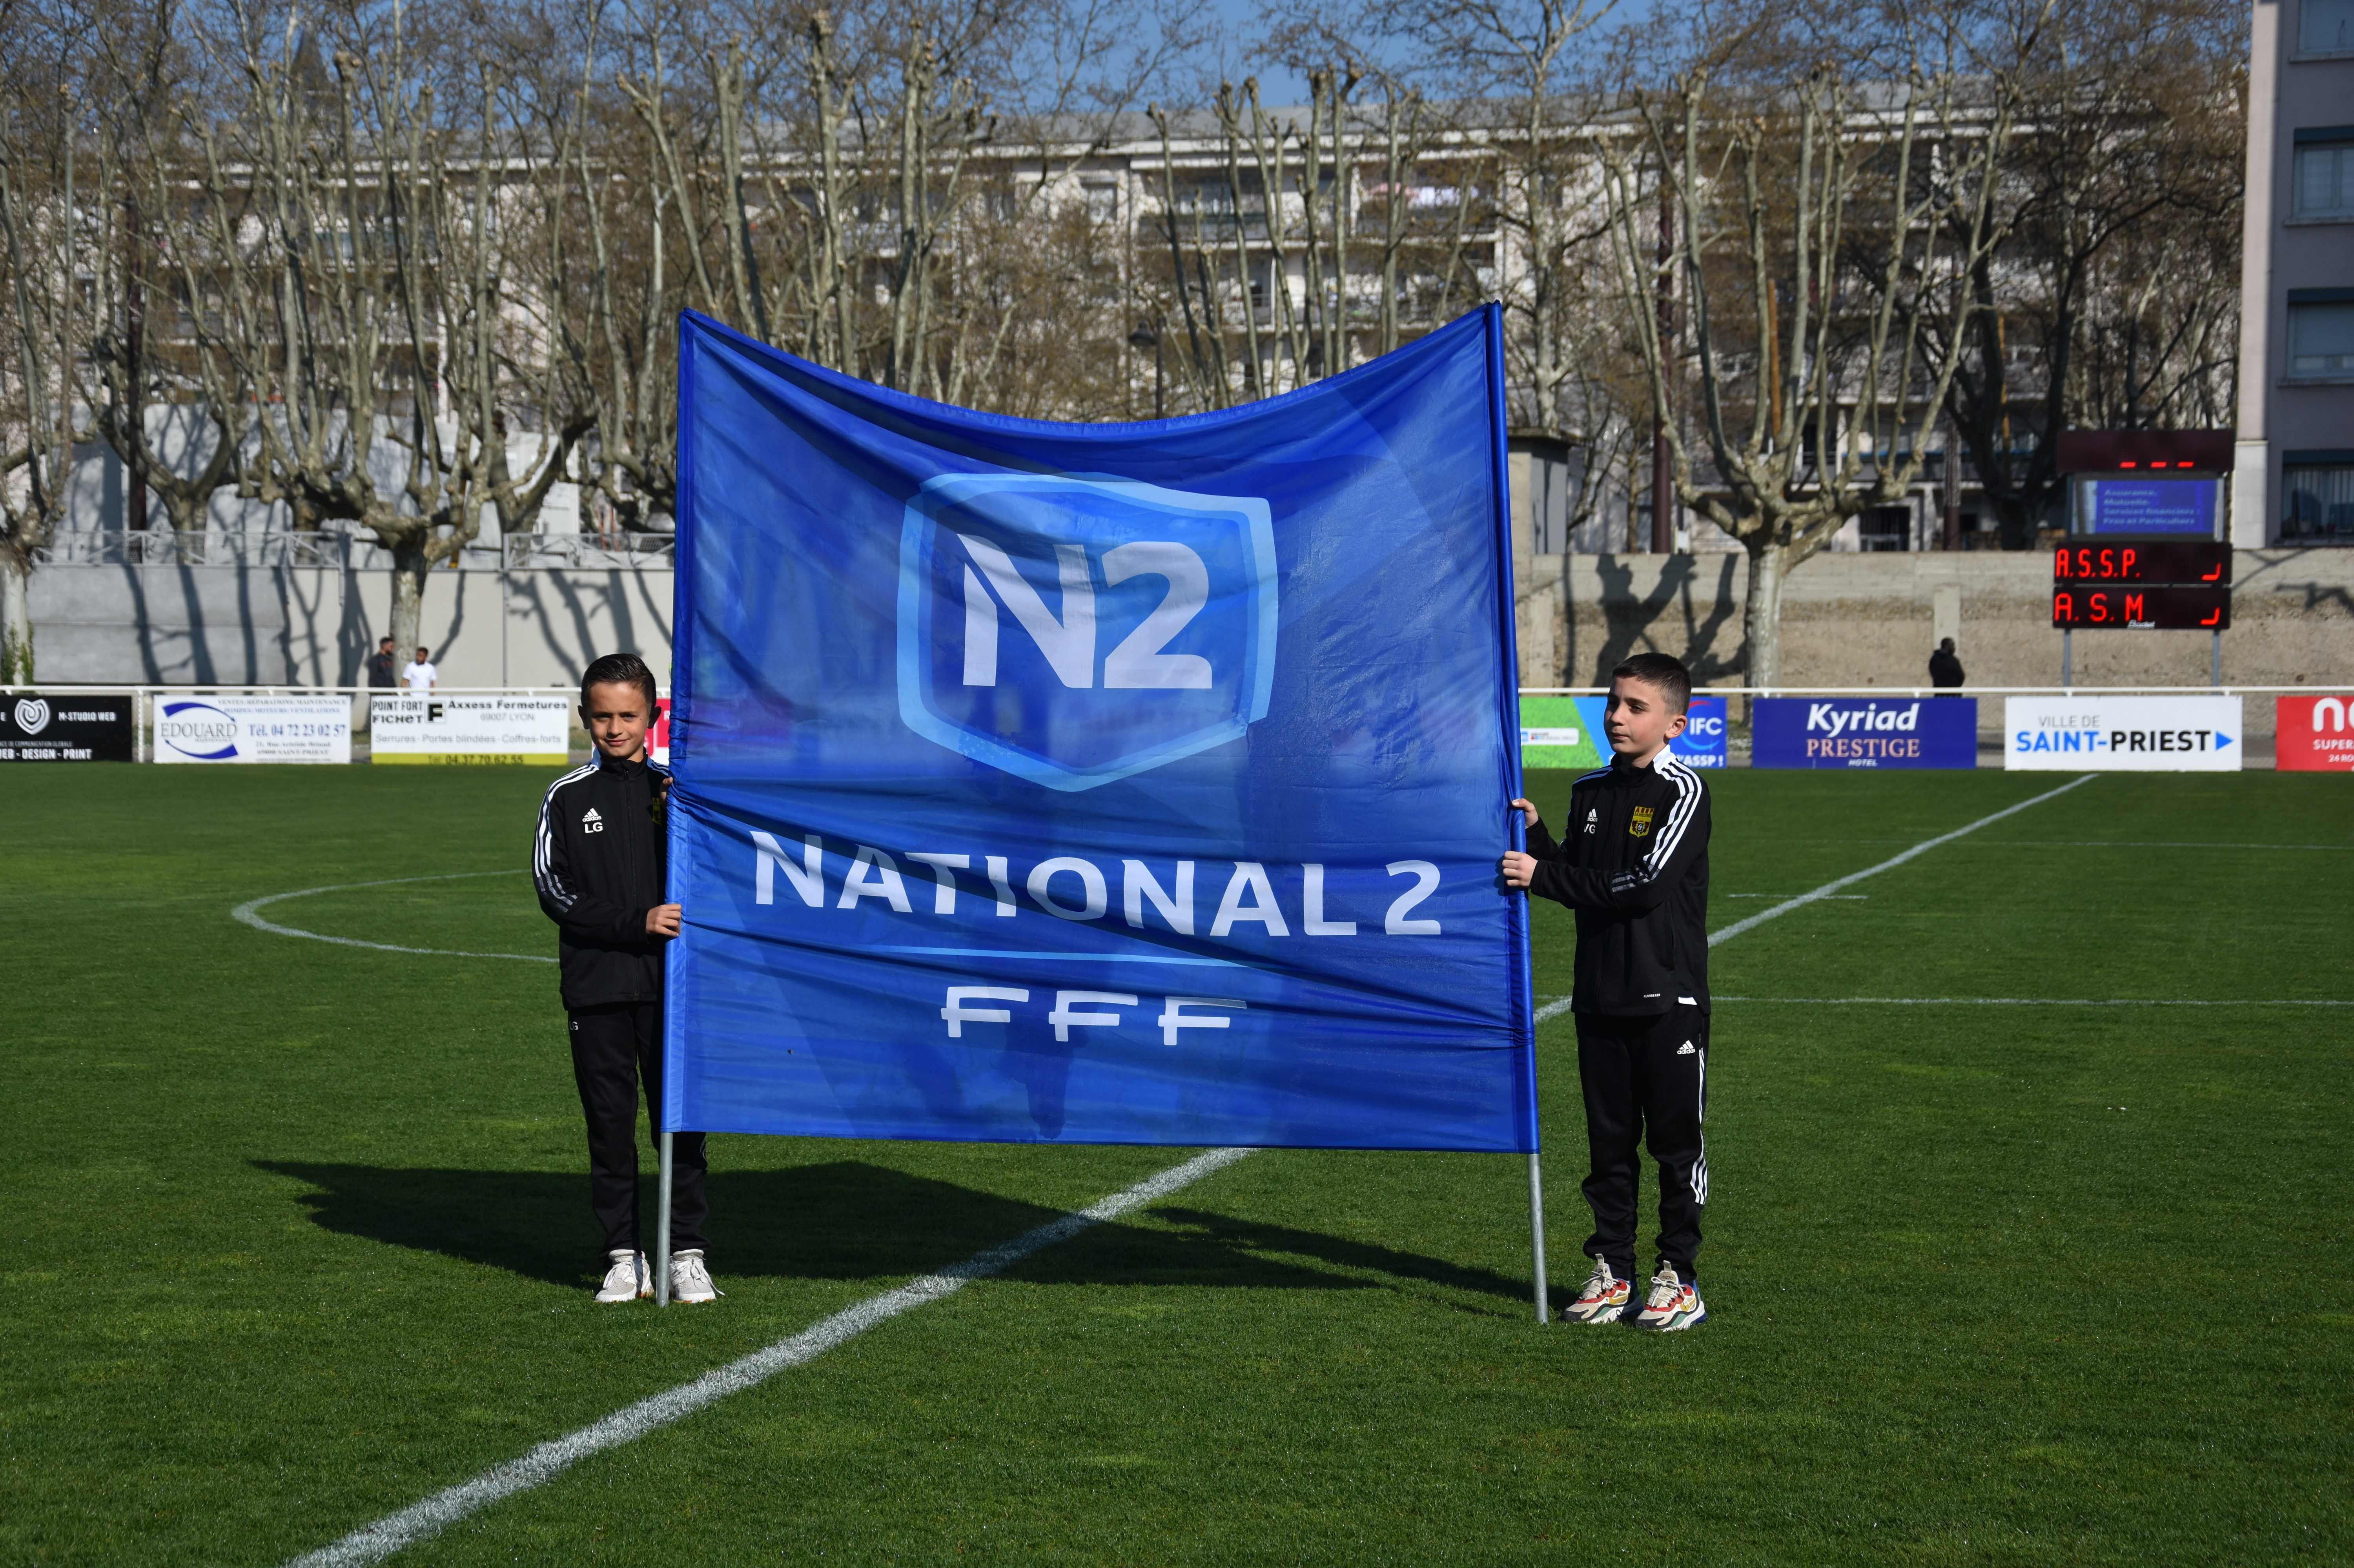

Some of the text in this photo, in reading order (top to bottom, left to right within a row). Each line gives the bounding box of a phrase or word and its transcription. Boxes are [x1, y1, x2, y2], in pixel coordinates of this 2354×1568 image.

[2055, 549, 2140, 577] A.S.S.P.
[957, 534, 1212, 688] N2
[373, 701, 423, 710] POINT FORT
[449, 700, 567, 708] Axxess Fermetures
[58, 712, 116, 721] M-STUDIO WEB
[1807, 703, 1921, 738] Kyriad
[2039, 716, 2101, 728] VILLE DE
[2313, 697, 2354, 733] n
[161, 722, 237, 737] EDOUARD
[271, 725, 283, 736] 04
[287, 725, 298, 736] 72
[302, 725, 314, 736] 23
[318, 725, 329, 736] 02
[333, 725, 346, 736] 57
[1690, 717, 1722, 735] IFC
[375, 734, 561, 743] Serrures Portes blindées Coffres-forts
[2016, 730, 2211, 752] SAINT-PRIEST
[22, 748, 56, 759] DESIGN
[63, 748, 92, 759] PRINT
[1806, 738, 1920, 758] PRESTIGE
[585, 822, 603, 833] LG
[749, 831, 1441, 936] NATIONAL 2
[941, 985, 1248, 1045] FFF
[569, 1021, 578, 1030] LG
